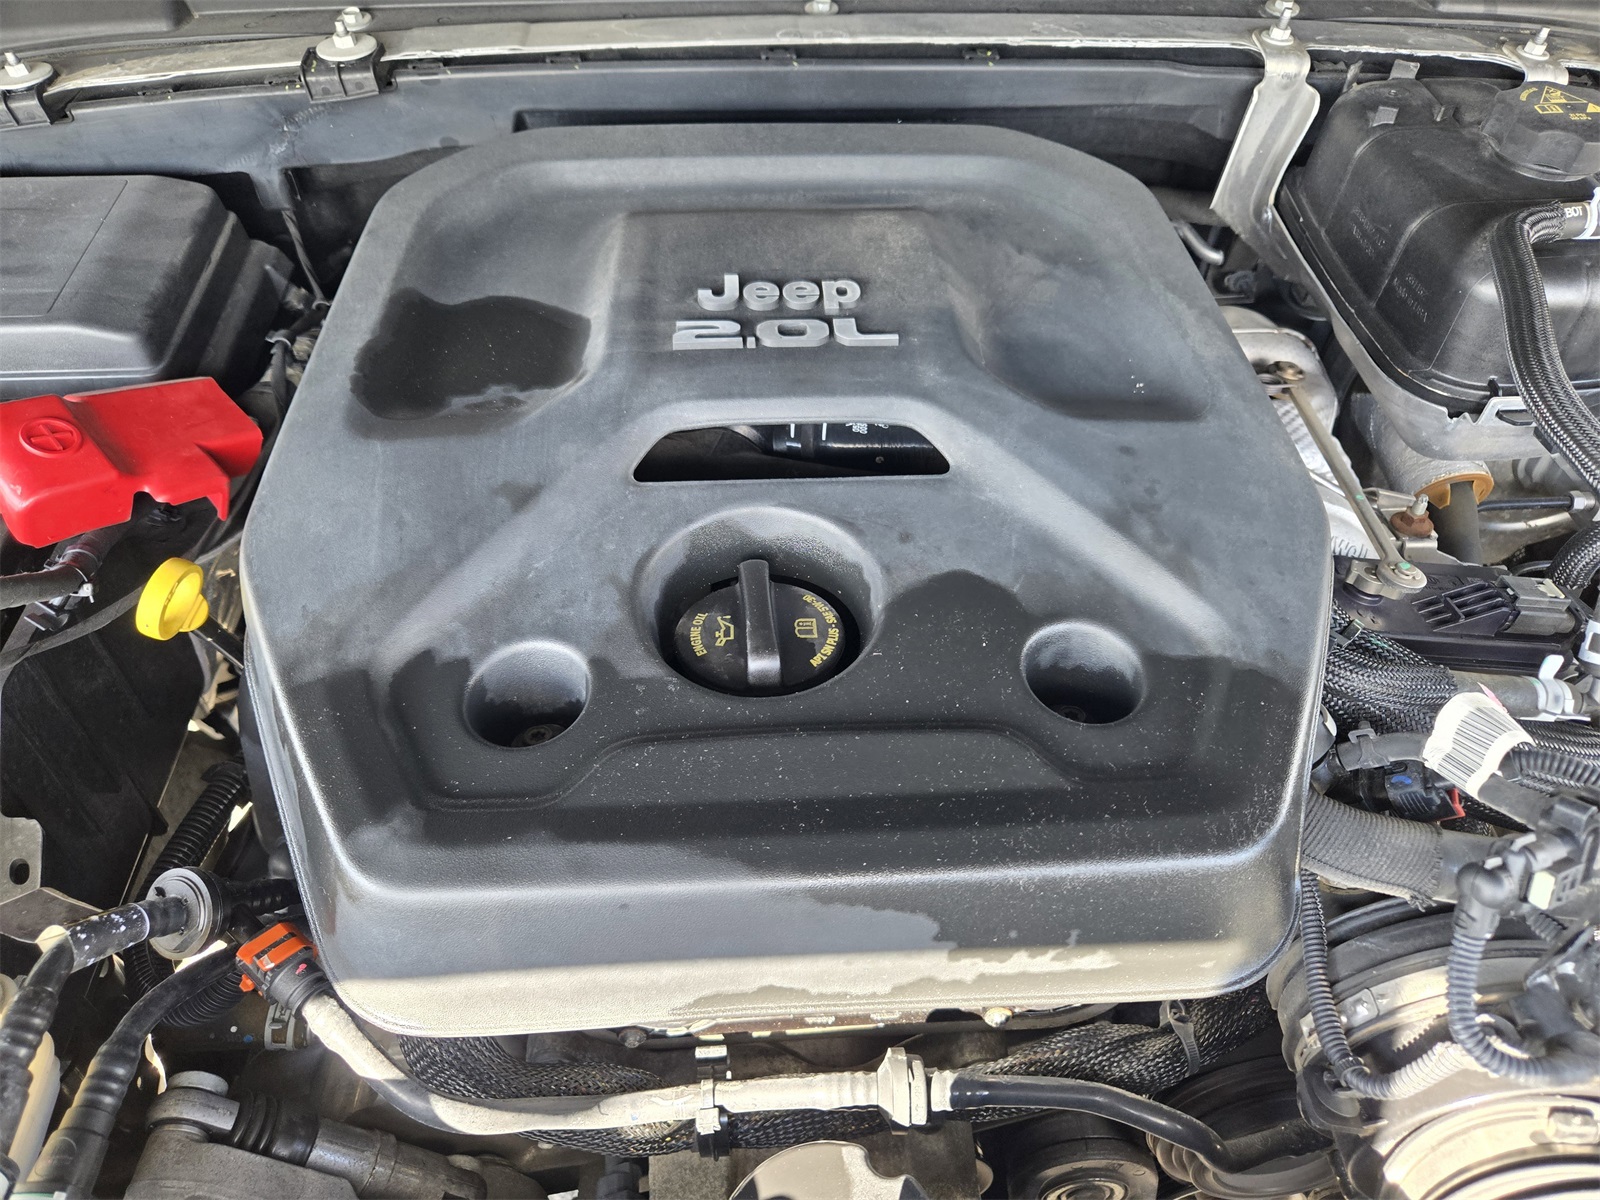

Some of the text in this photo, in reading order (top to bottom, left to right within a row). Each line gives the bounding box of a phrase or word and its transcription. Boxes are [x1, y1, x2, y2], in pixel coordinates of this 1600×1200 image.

[697, 274, 861, 315] Jeep
[673, 317, 899, 350] 2.0L
[690, 612, 709, 657] ENGINE OIL
[802, 594, 840, 668] API SN PLUS SAE 5W-30
